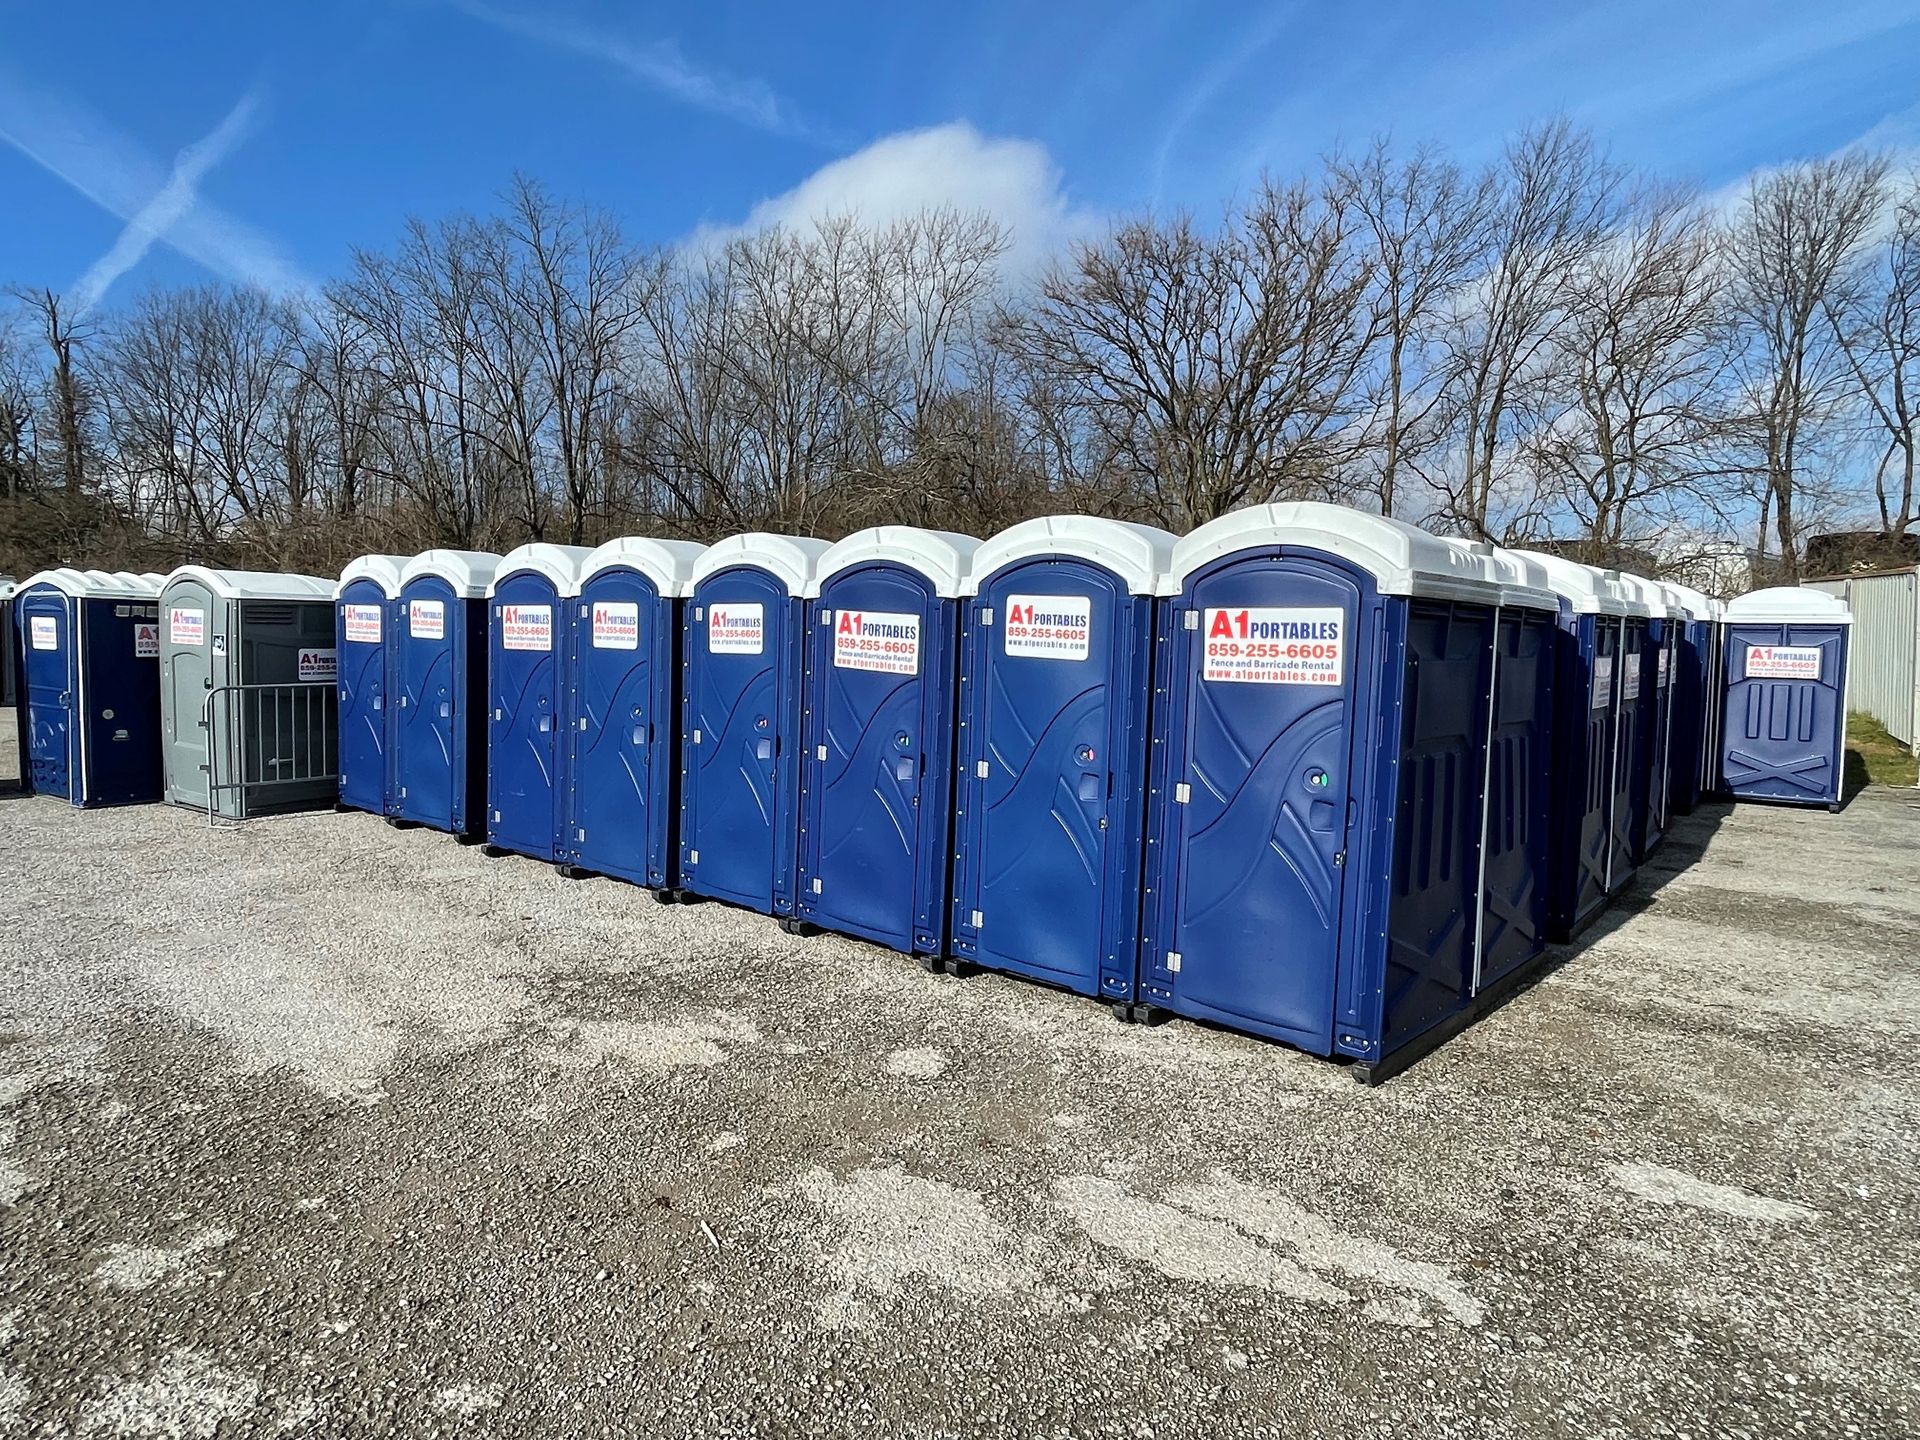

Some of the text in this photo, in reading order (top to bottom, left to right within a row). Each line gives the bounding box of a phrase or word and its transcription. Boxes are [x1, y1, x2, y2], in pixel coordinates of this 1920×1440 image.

[347, 606, 356, 620] A1
[412, 606, 421, 618] A1
[505, 607, 549, 625] A1 PORTABLES
[595, 610, 636, 625] A1 PORTABLES
[1009, 604, 1087, 627] A1 PORTABLES
[712, 611, 760, 628] A1 PORTABLES
[838, 612, 916, 640] A1 PORTABLES
[1209, 610, 1338, 640] A1 PORTABLES
[505, 626, 549, 635] 859-255-6605
[712, 630, 760, 638] 859-255-6605
[1008, 626, 1086, 640] 859-255-6605
[838, 637, 915, 654] 859-255-6605
[1208, 643, 1337, 659] 859-255-6605
[301, 654, 318, 664] A1
[864, 652, 892, 660] Barricade
[1750, 648, 1816, 661] A1 PORTABLES
[1211, 659, 1334, 670] Fence and Barricade Rental
[1208, 669, 1337, 682] www.a1portables.com
